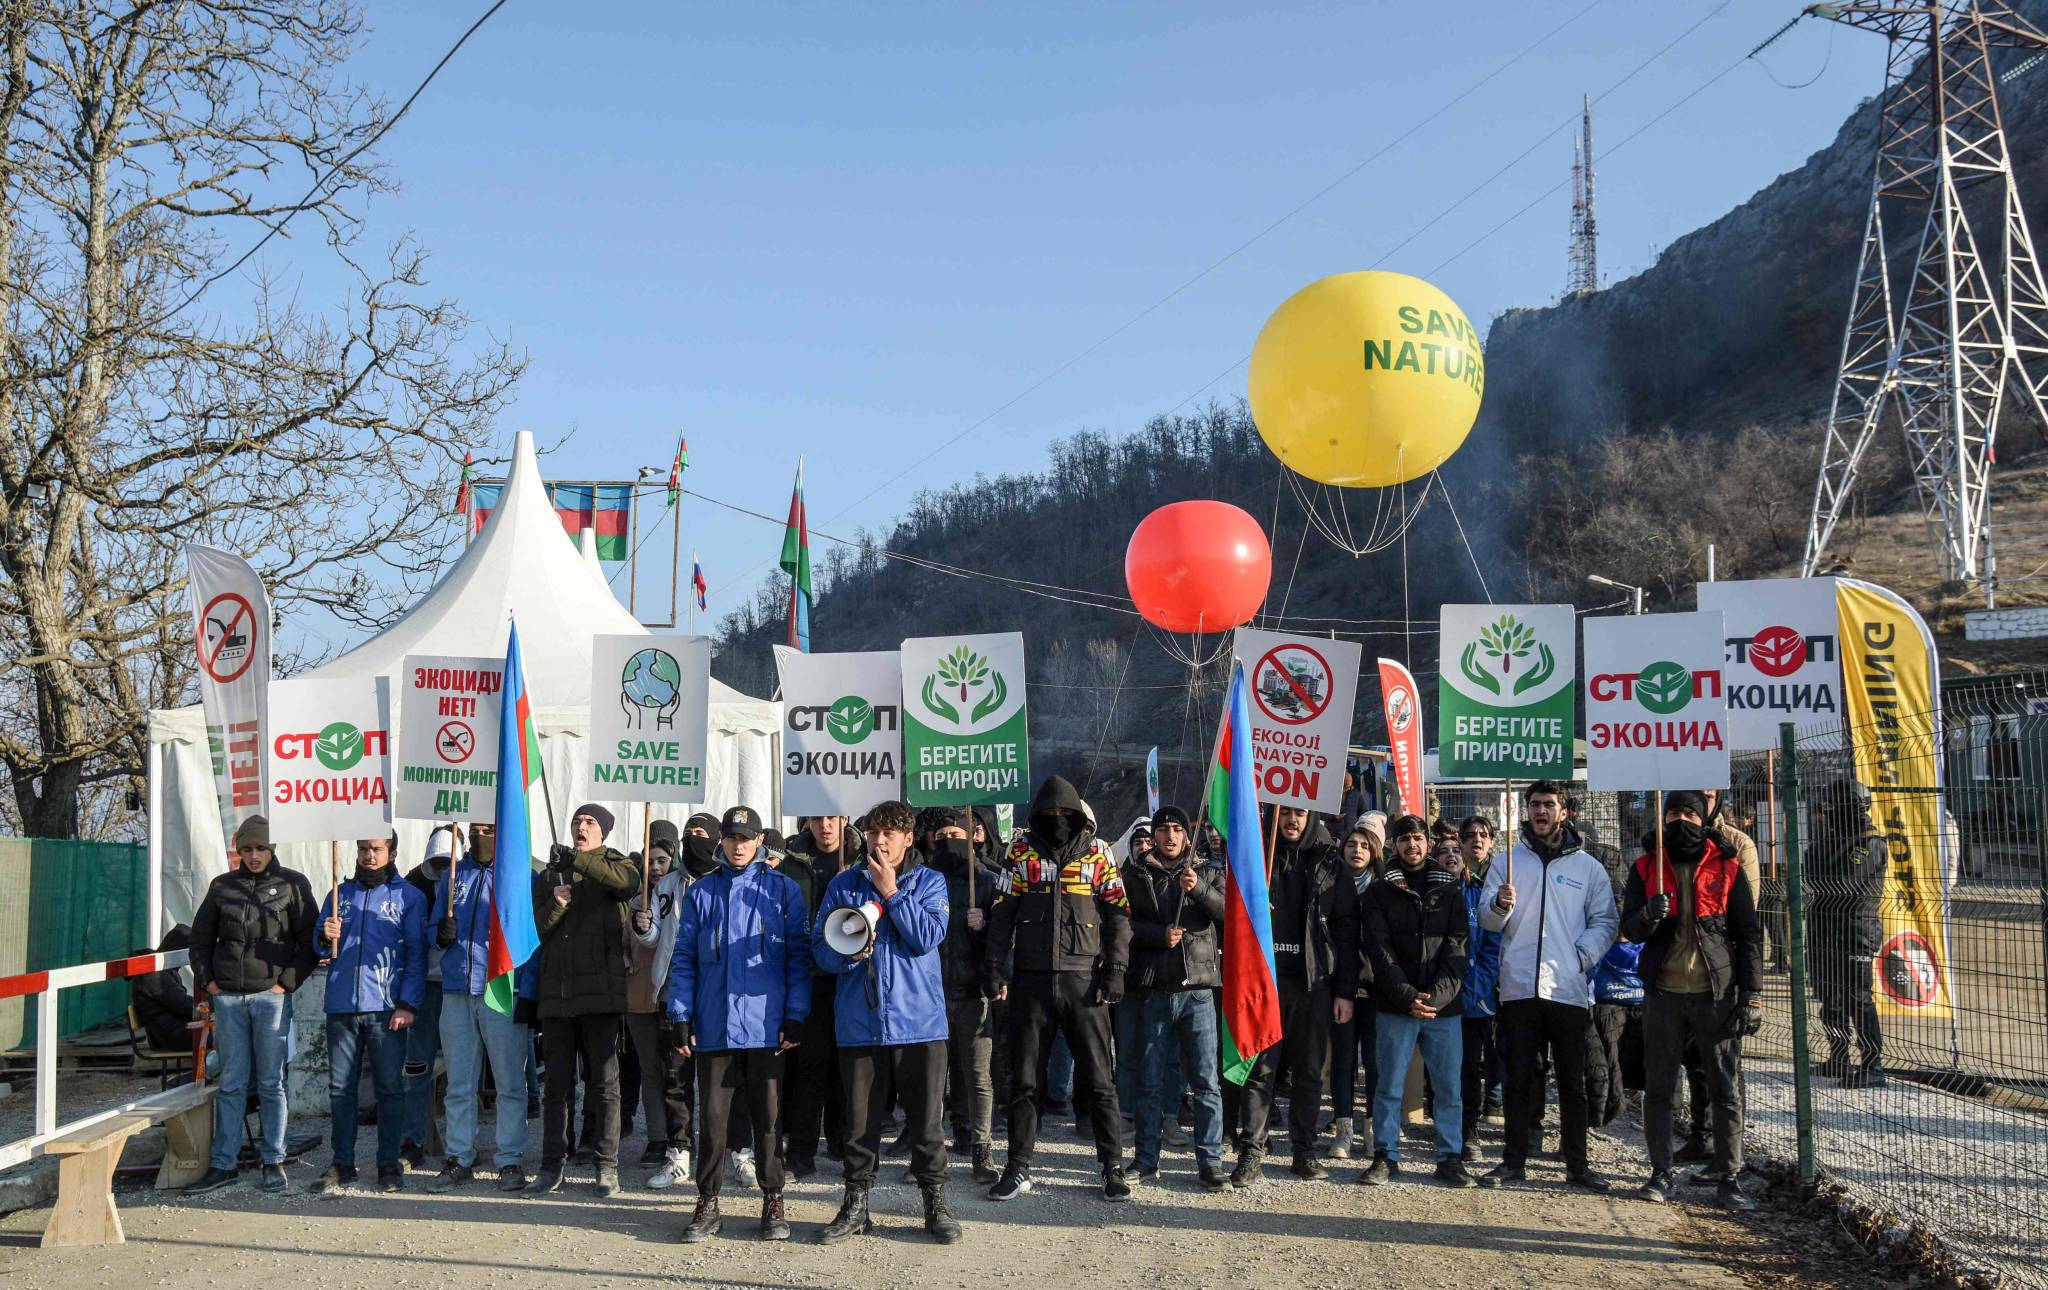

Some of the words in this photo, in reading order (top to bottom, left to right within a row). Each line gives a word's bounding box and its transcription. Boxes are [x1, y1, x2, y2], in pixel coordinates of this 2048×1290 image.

[1398, 305, 1478, 352] SAVE
[1725, 626, 1834, 677] ТОП
[414, 667, 502, 695] ЭКОЦИДУ
[438, 696, 477, 718] НЕТ!
[1727, 683, 1835, 713] КОЦИД
[1252, 727, 1321, 751] EKOLOJİ
[1454, 715, 1563, 739] БЕРЕГИТЕ
[1591, 721, 1724, 752] ЭКОЦИД
[617, 741, 679, 761] SAVE
[920, 742, 1017, 767] БЕРЕГИТЕ
[1454, 740, 1563, 766] ПРИРОДУ!
[593, 763, 700, 787] NATURE!
[787, 751, 896, 780] ЭКОЦИД
[274, 776, 389, 806] ЭКОЦИД
[920, 768, 1019, 793] ПРИРОДУ!
[433, 789, 471, 815] ДА!
